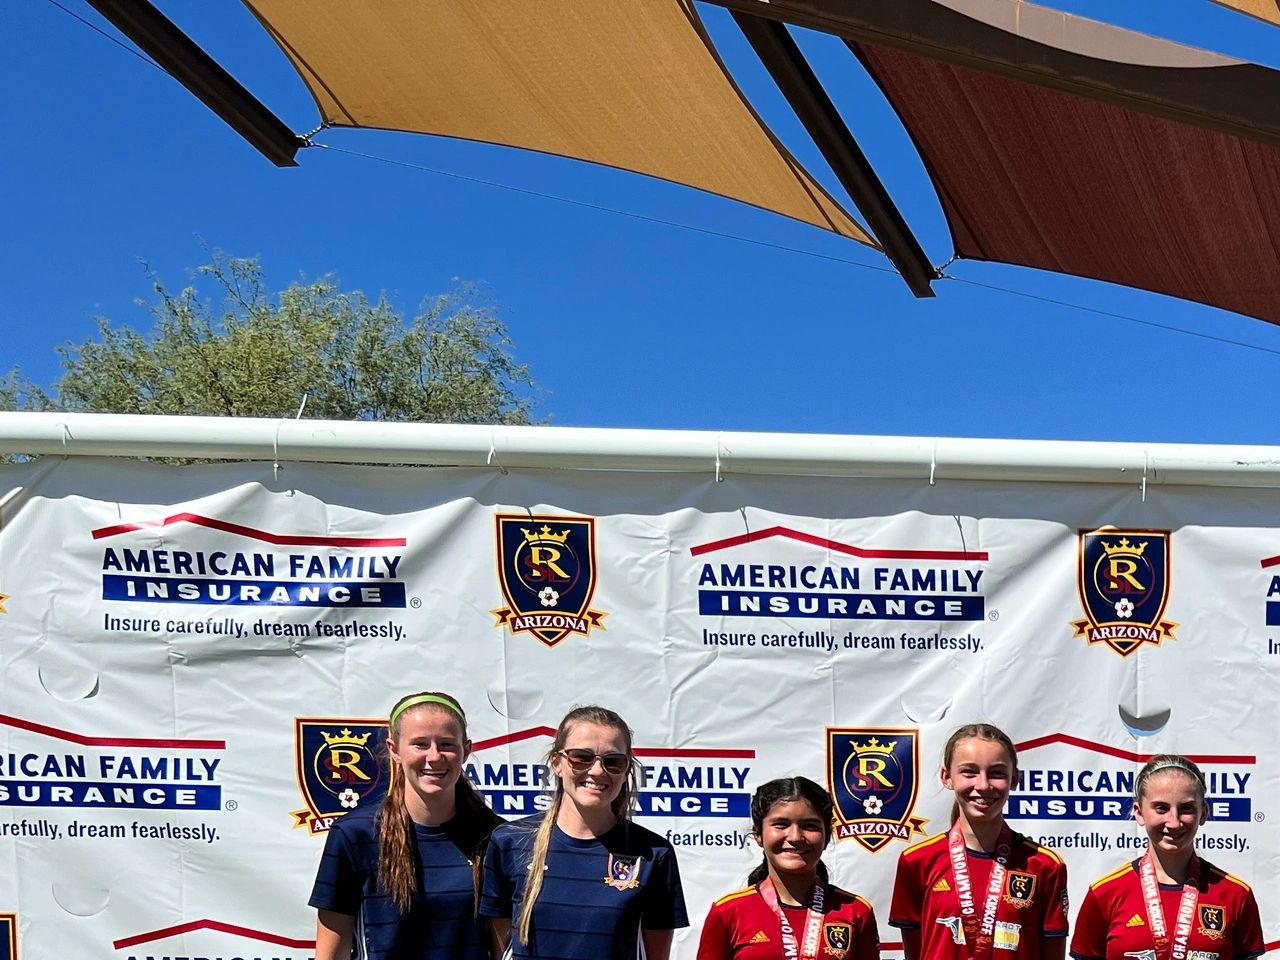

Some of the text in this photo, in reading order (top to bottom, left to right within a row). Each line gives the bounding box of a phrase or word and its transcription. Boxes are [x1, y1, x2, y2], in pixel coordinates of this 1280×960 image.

[101, 547, 402, 580] AMERICAN FAMILY
[699, 563, 984, 593] AMERICAN FAMILY
[127, 580, 382, 604] INSURANCE
[721, 596, 962, 616] INSURANCE
[104, 613, 407, 641] Insure carefully, dream fearlessly.
[514, 615, 587, 631] ARIZONA
[1091, 623, 1160, 644] ARIZONA
[702, 628, 984, 653] Insure carefully, dream fearlessly.
[0, 753, 220, 781] ICAN FAMILY
[464, 764, 750, 789] AMER FAMILY
[1019, 770, 1134, 792] ERICAN
[0, 820, 220, 844] refully, dream fearlessly.
[666, 829, 751, 848] fearlessly.
[839, 821, 908, 841] ARIZONA
[1039, 832, 1250, 852] carefully, drea rlessly.
[952, 846, 974, 915] CHAMPIONS
[982, 895, 999, 935] KICKOFF
[1173, 892, 1196, 960] CHAMPIONS
